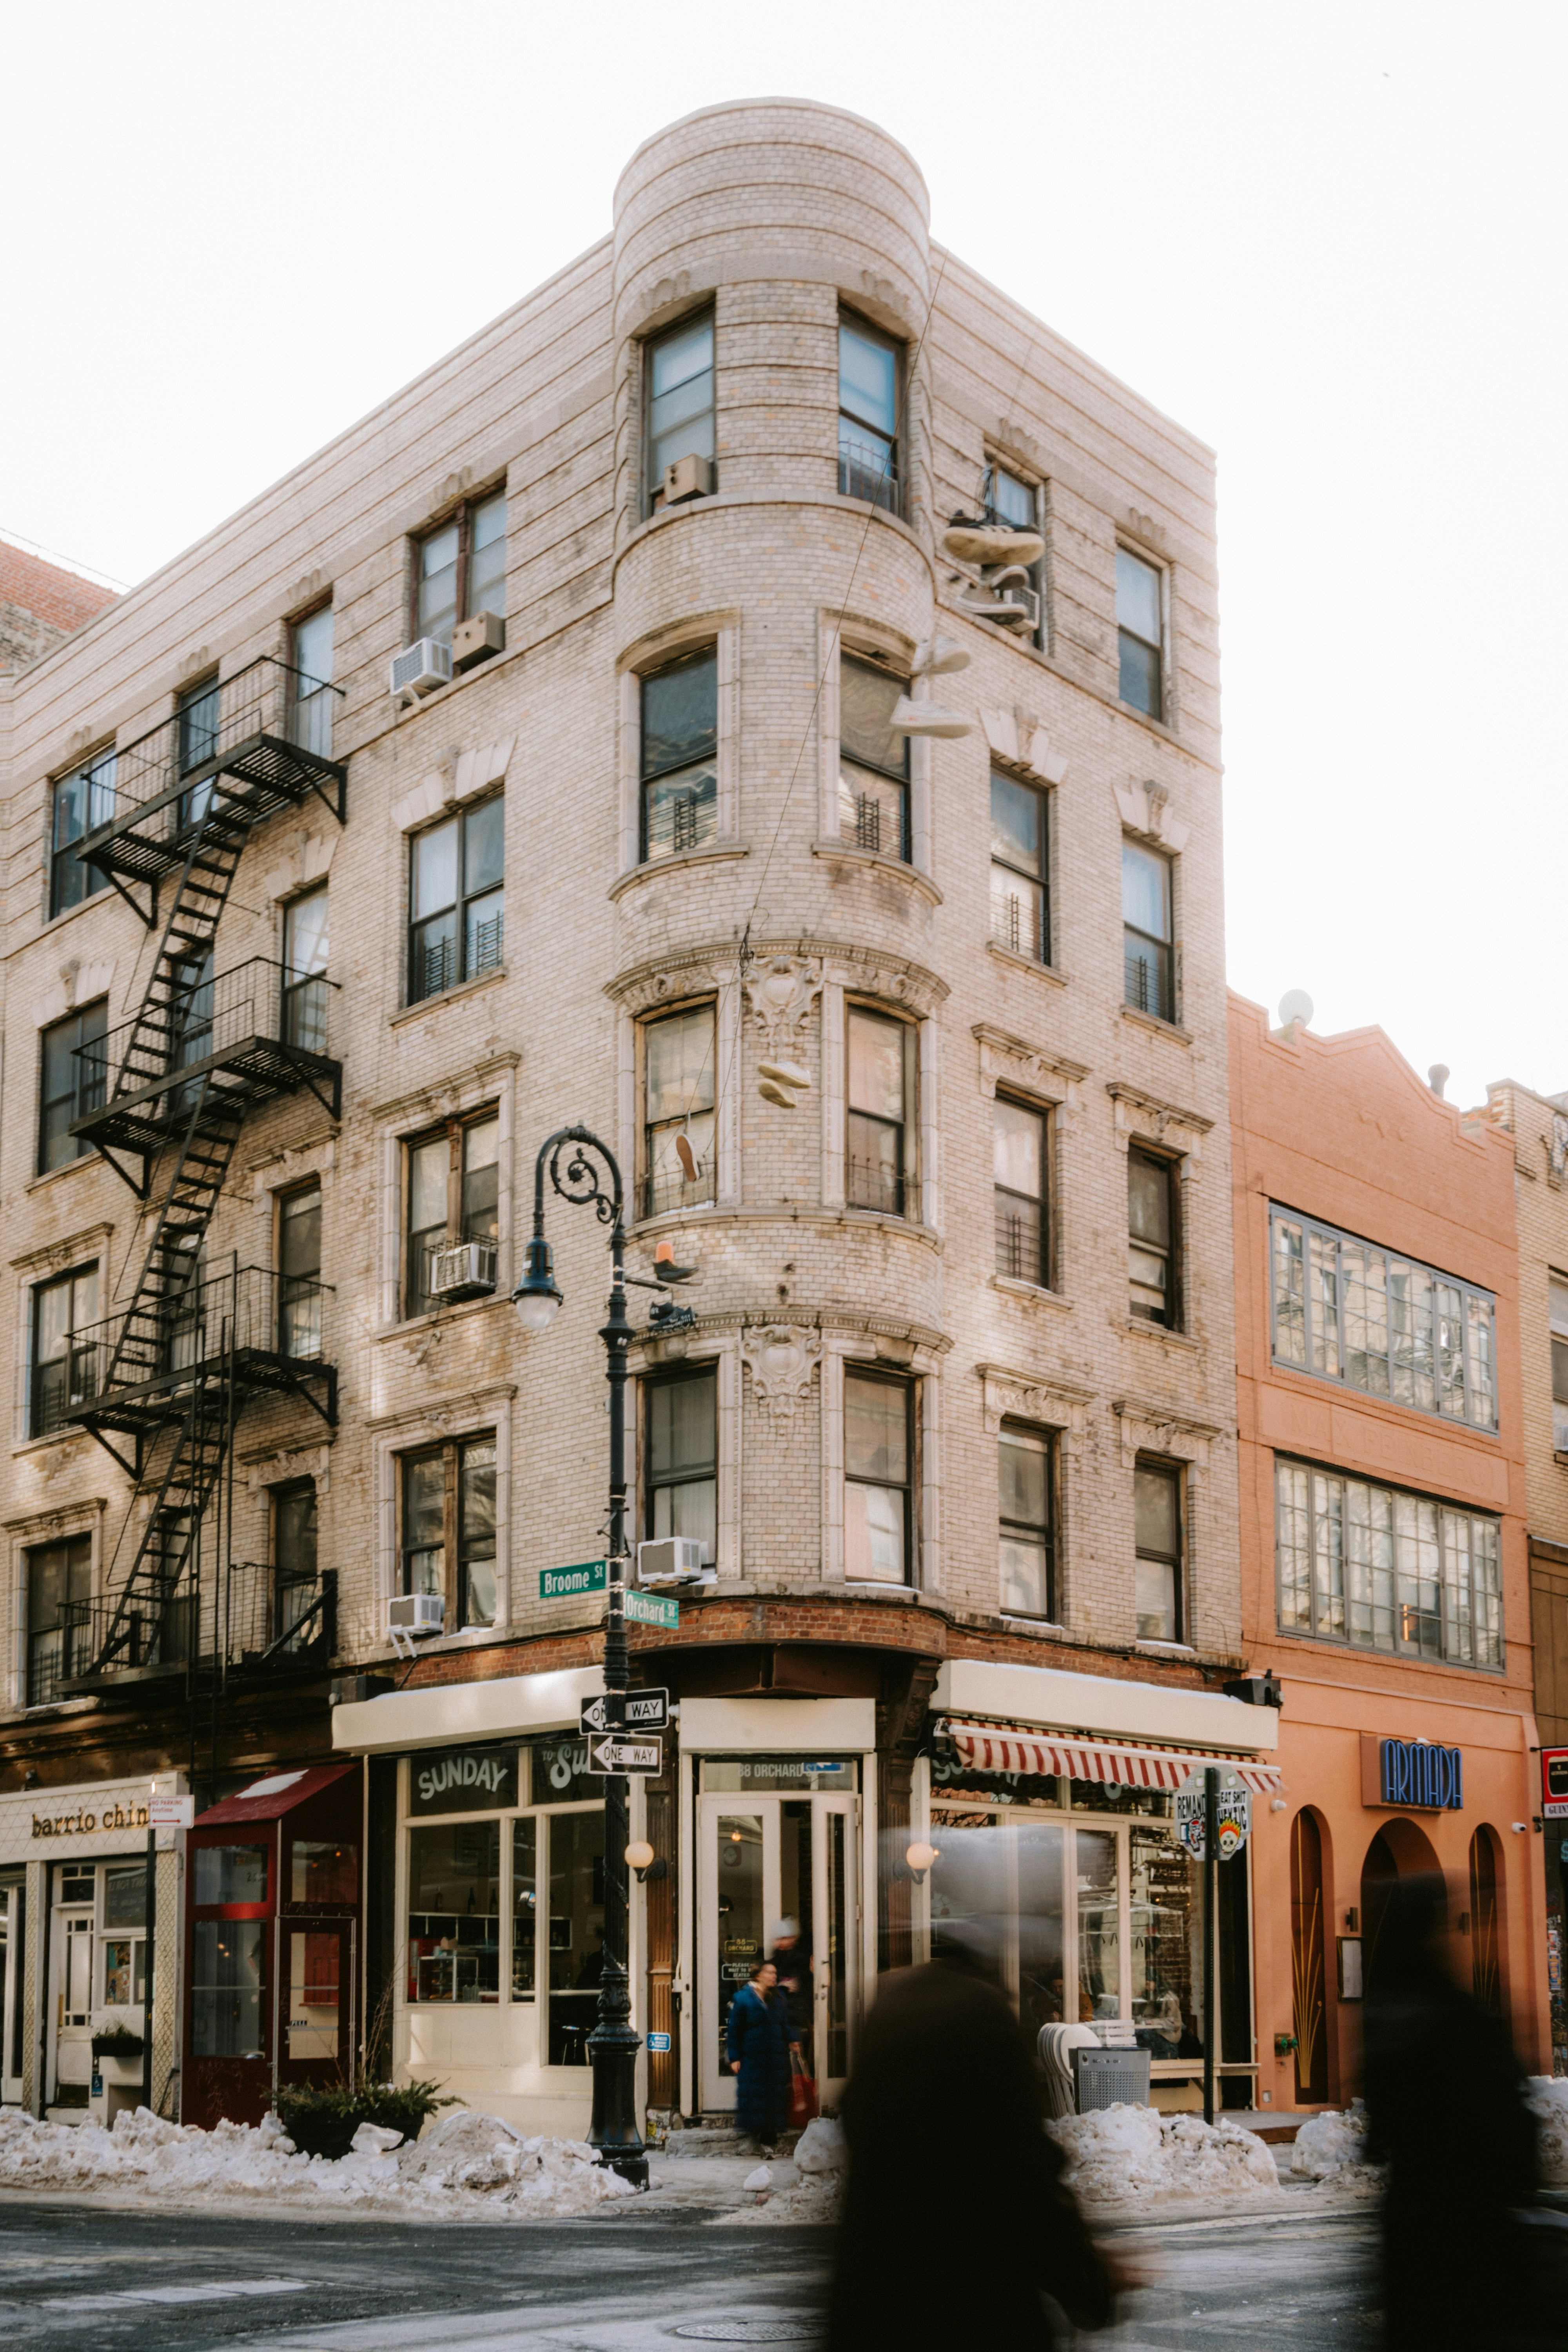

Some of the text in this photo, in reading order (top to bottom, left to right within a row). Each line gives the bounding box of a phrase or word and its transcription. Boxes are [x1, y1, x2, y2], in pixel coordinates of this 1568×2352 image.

[544, 1564, 603, 1594] Broome St
[627, 1594, 675, 1623] Orchard St
[632, 1701, 659, 1718] WAY
[604, 1747, 653, 1763] ONE WAY
[418, 1757, 508, 1800] SUNDAY
[736, 1764, 751, 1777] 88
[754, 1764, 803, 1777] ORCHARD
[1385, 1740, 1463, 1808] ARMADA
[32, 1800, 149, 1838] barrio chin
